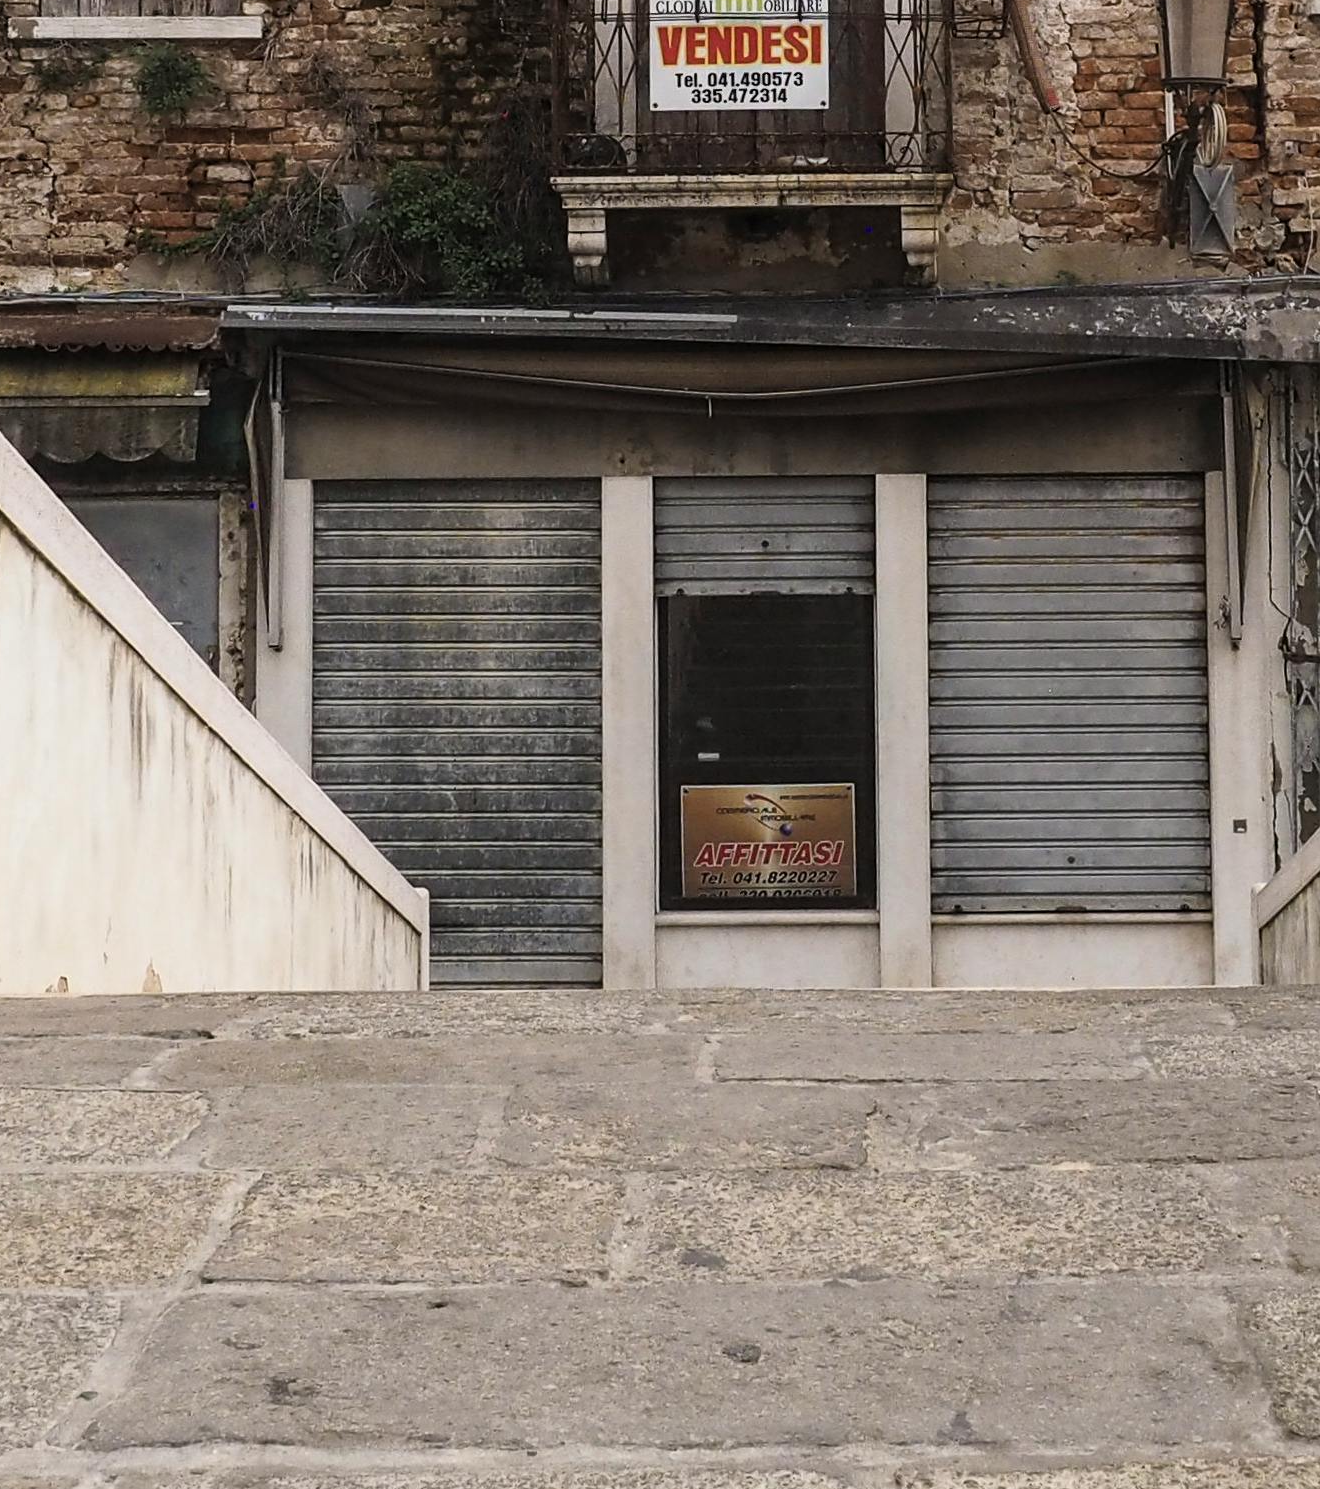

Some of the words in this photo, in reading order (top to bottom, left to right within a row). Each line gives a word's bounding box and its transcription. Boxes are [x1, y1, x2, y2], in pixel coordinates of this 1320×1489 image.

[657, 24, 822, 66] VENDESI
[675, 72, 702, 88] Tel.
[707, 71, 803, 88] 041.490573
[691, 89, 787, 104] 335.472314
[693, 840, 844, 867] AFFITTASI
[701, 872, 726, 885] Tel.
[733, 870, 838, 885] 041.8220227
